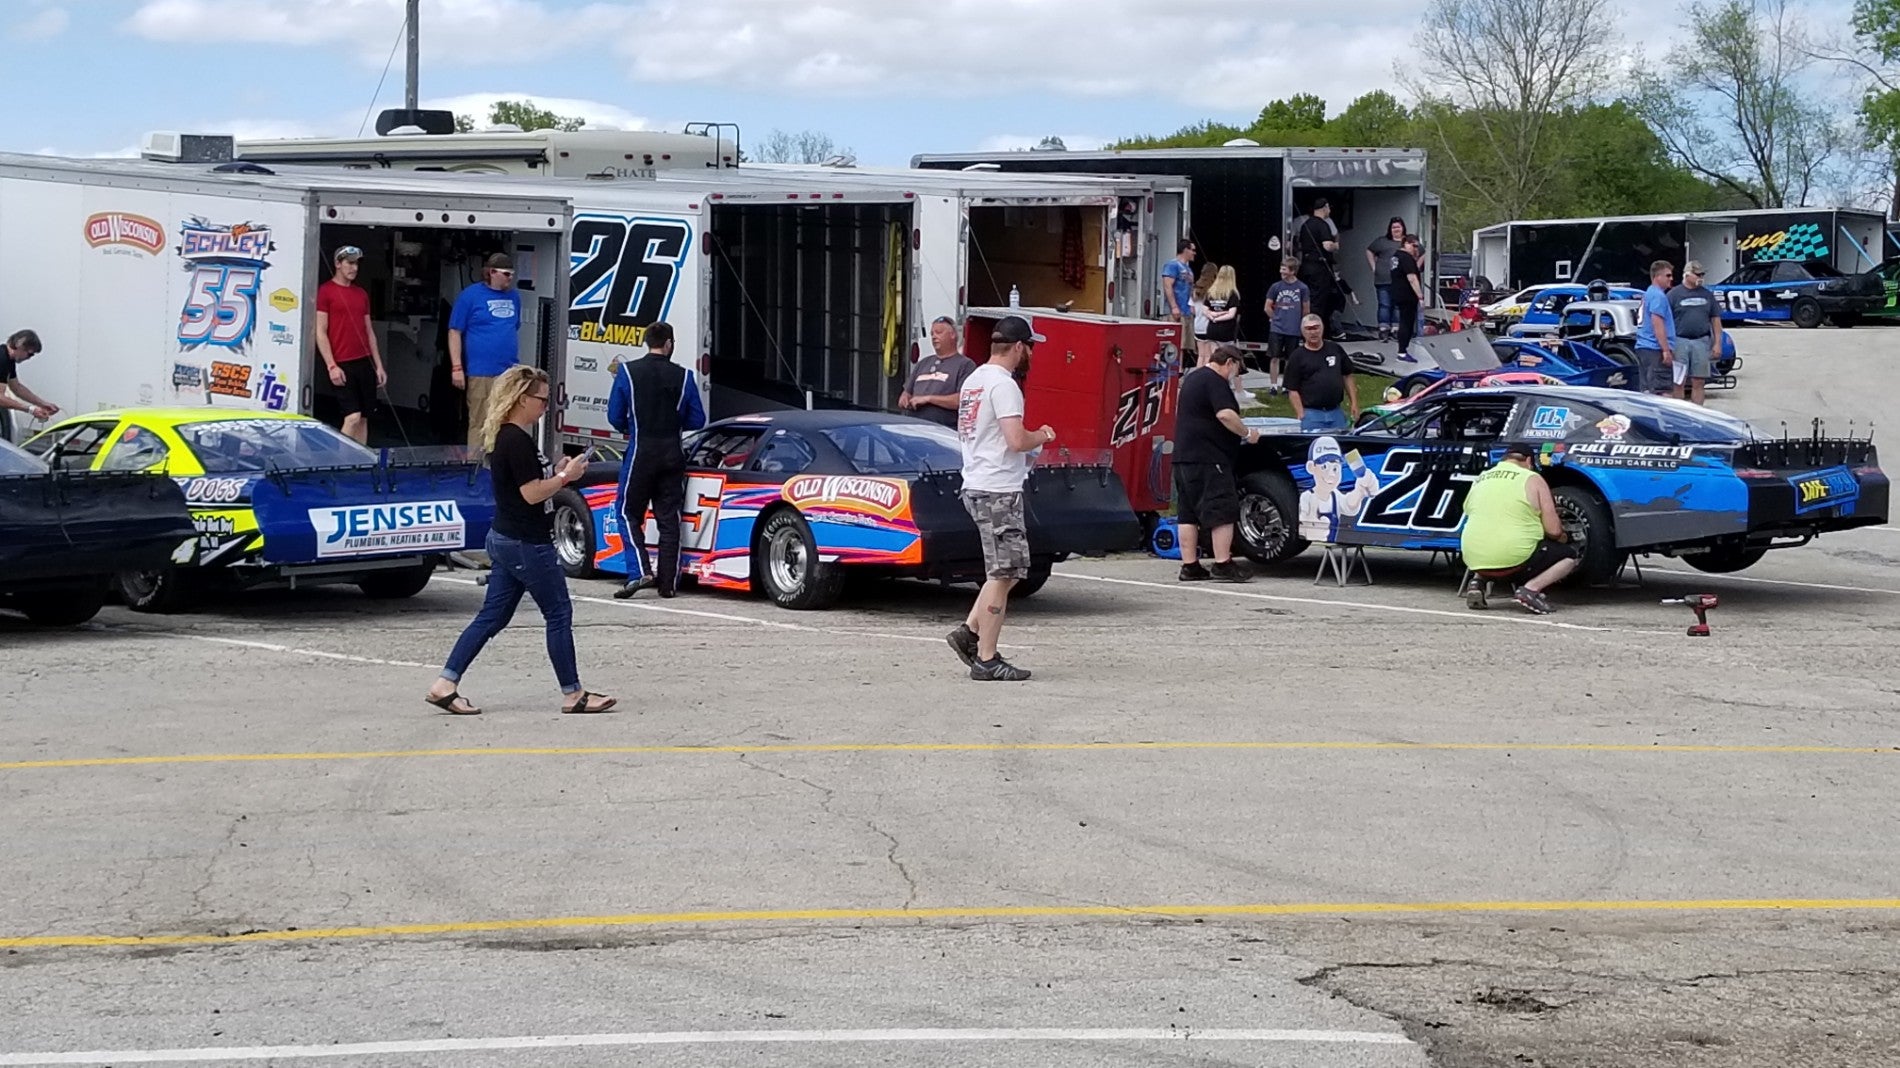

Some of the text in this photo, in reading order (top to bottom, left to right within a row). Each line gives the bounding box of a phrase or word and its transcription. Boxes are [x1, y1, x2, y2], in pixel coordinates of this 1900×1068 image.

[91, 215, 159, 245] OLD WISCONSIN
[184, 231, 268, 257] SCHLEY
[569, 216, 690, 328] 26
[180, 267, 257, 342] 55
[211, 361, 251, 380] TSCS
[1111, 380, 1165, 445] 26
[1580, 457, 1622, 466] CUSTOM
[1627, 459, 1653, 467] CARE
[186, 478, 249, 501] DOGS
[793, 475, 897, 507] OLD WISCONSIN
[1357, 447, 1474, 532] 26
[326, 504, 454, 544] JENSEN
[344, 531, 461, 548] PLUMBING, HEATING & AIR, INC.
